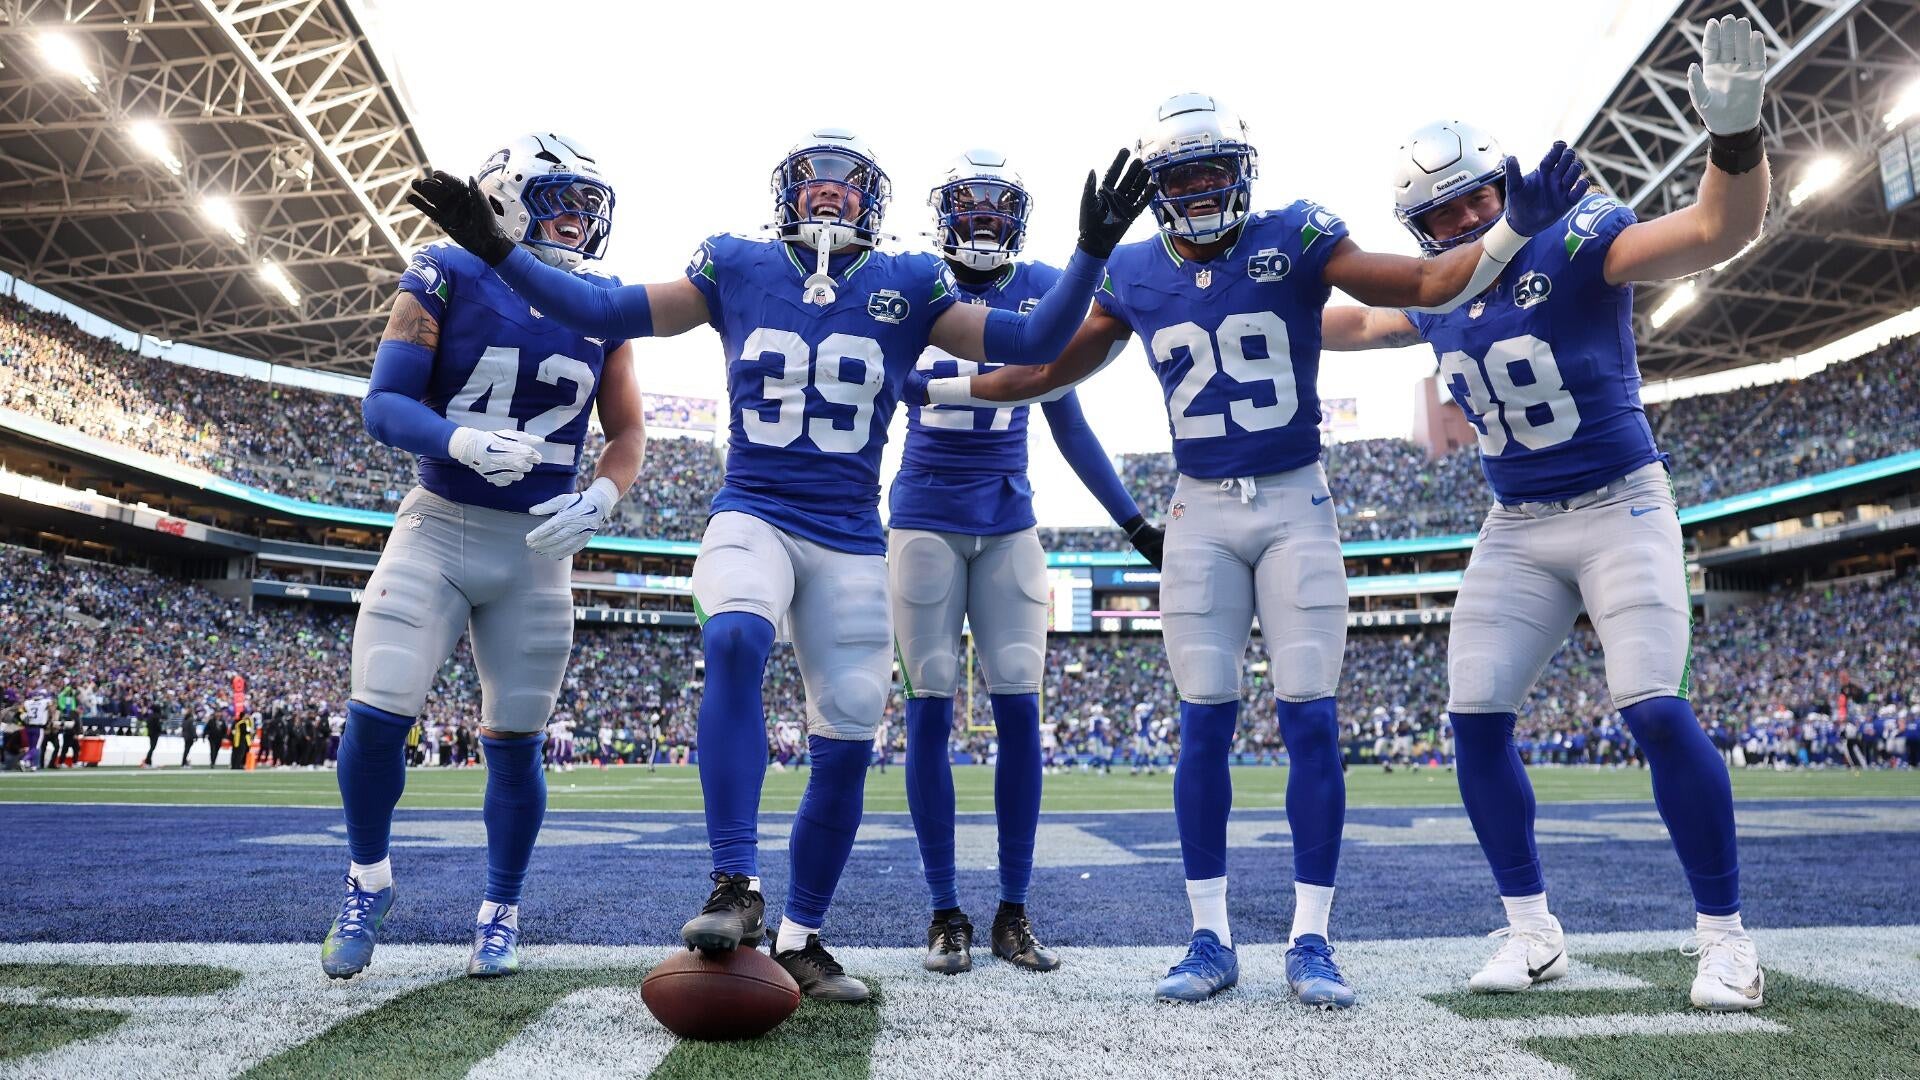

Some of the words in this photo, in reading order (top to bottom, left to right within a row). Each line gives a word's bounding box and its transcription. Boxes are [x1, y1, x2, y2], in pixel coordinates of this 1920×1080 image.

[1436, 174, 1468, 191] Seahawks
[1247, 253, 1291, 280] 50
[1513, 273, 1552, 308] 50
[867, 293, 910, 321] 50
[740, 328, 885, 454] 39
[1151, 311, 1299, 440] 29
[446, 346, 595, 467] 42
[1440, 334, 1582, 457] 38
[601, 609, 660, 625] FIELD
[1347, 612, 1405, 628] HOME
[1421, 610, 1445, 624] OF
